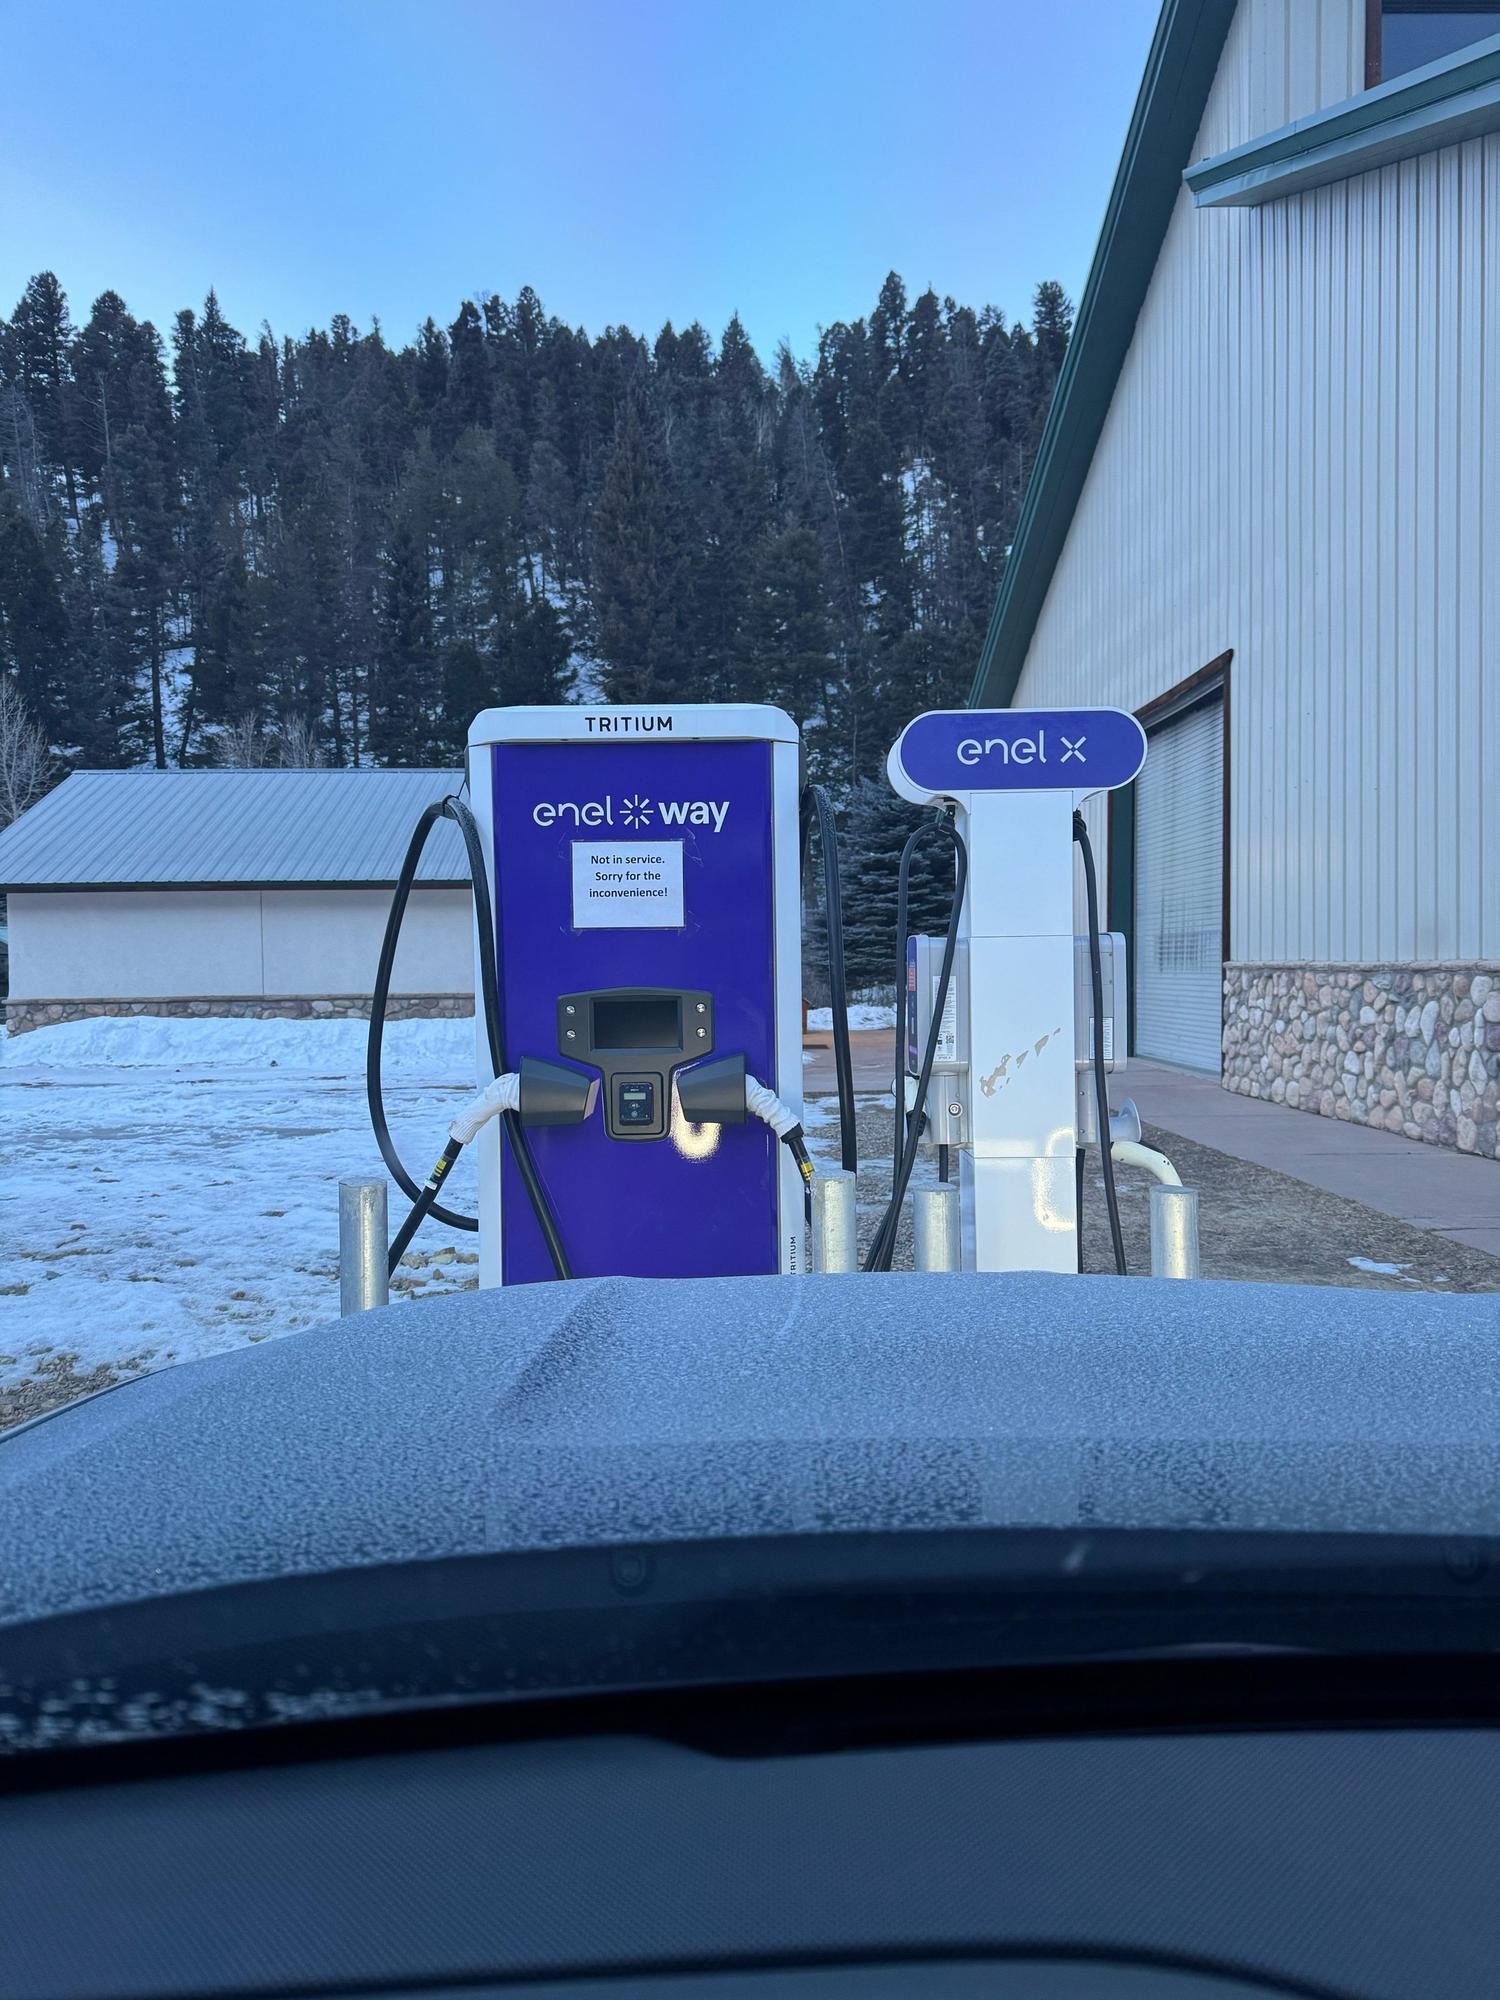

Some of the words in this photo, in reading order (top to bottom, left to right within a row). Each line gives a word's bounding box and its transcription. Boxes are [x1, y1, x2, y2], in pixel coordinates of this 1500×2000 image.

[585, 716, 673, 732] TRITIUM
[957, 729, 1047, 766] enel
[532, 795, 614, 827] enel
[658, 801, 730, 833] way
[591, 855, 610, 865] Not
[612, 854, 623, 864] in
[625, 854, 665, 864] service.
[595, 871, 623, 883] Sorry
[625, 870, 641, 881] for
[643, 870, 661, 881] the
[589, 887, 668, 898] inconvenience!
